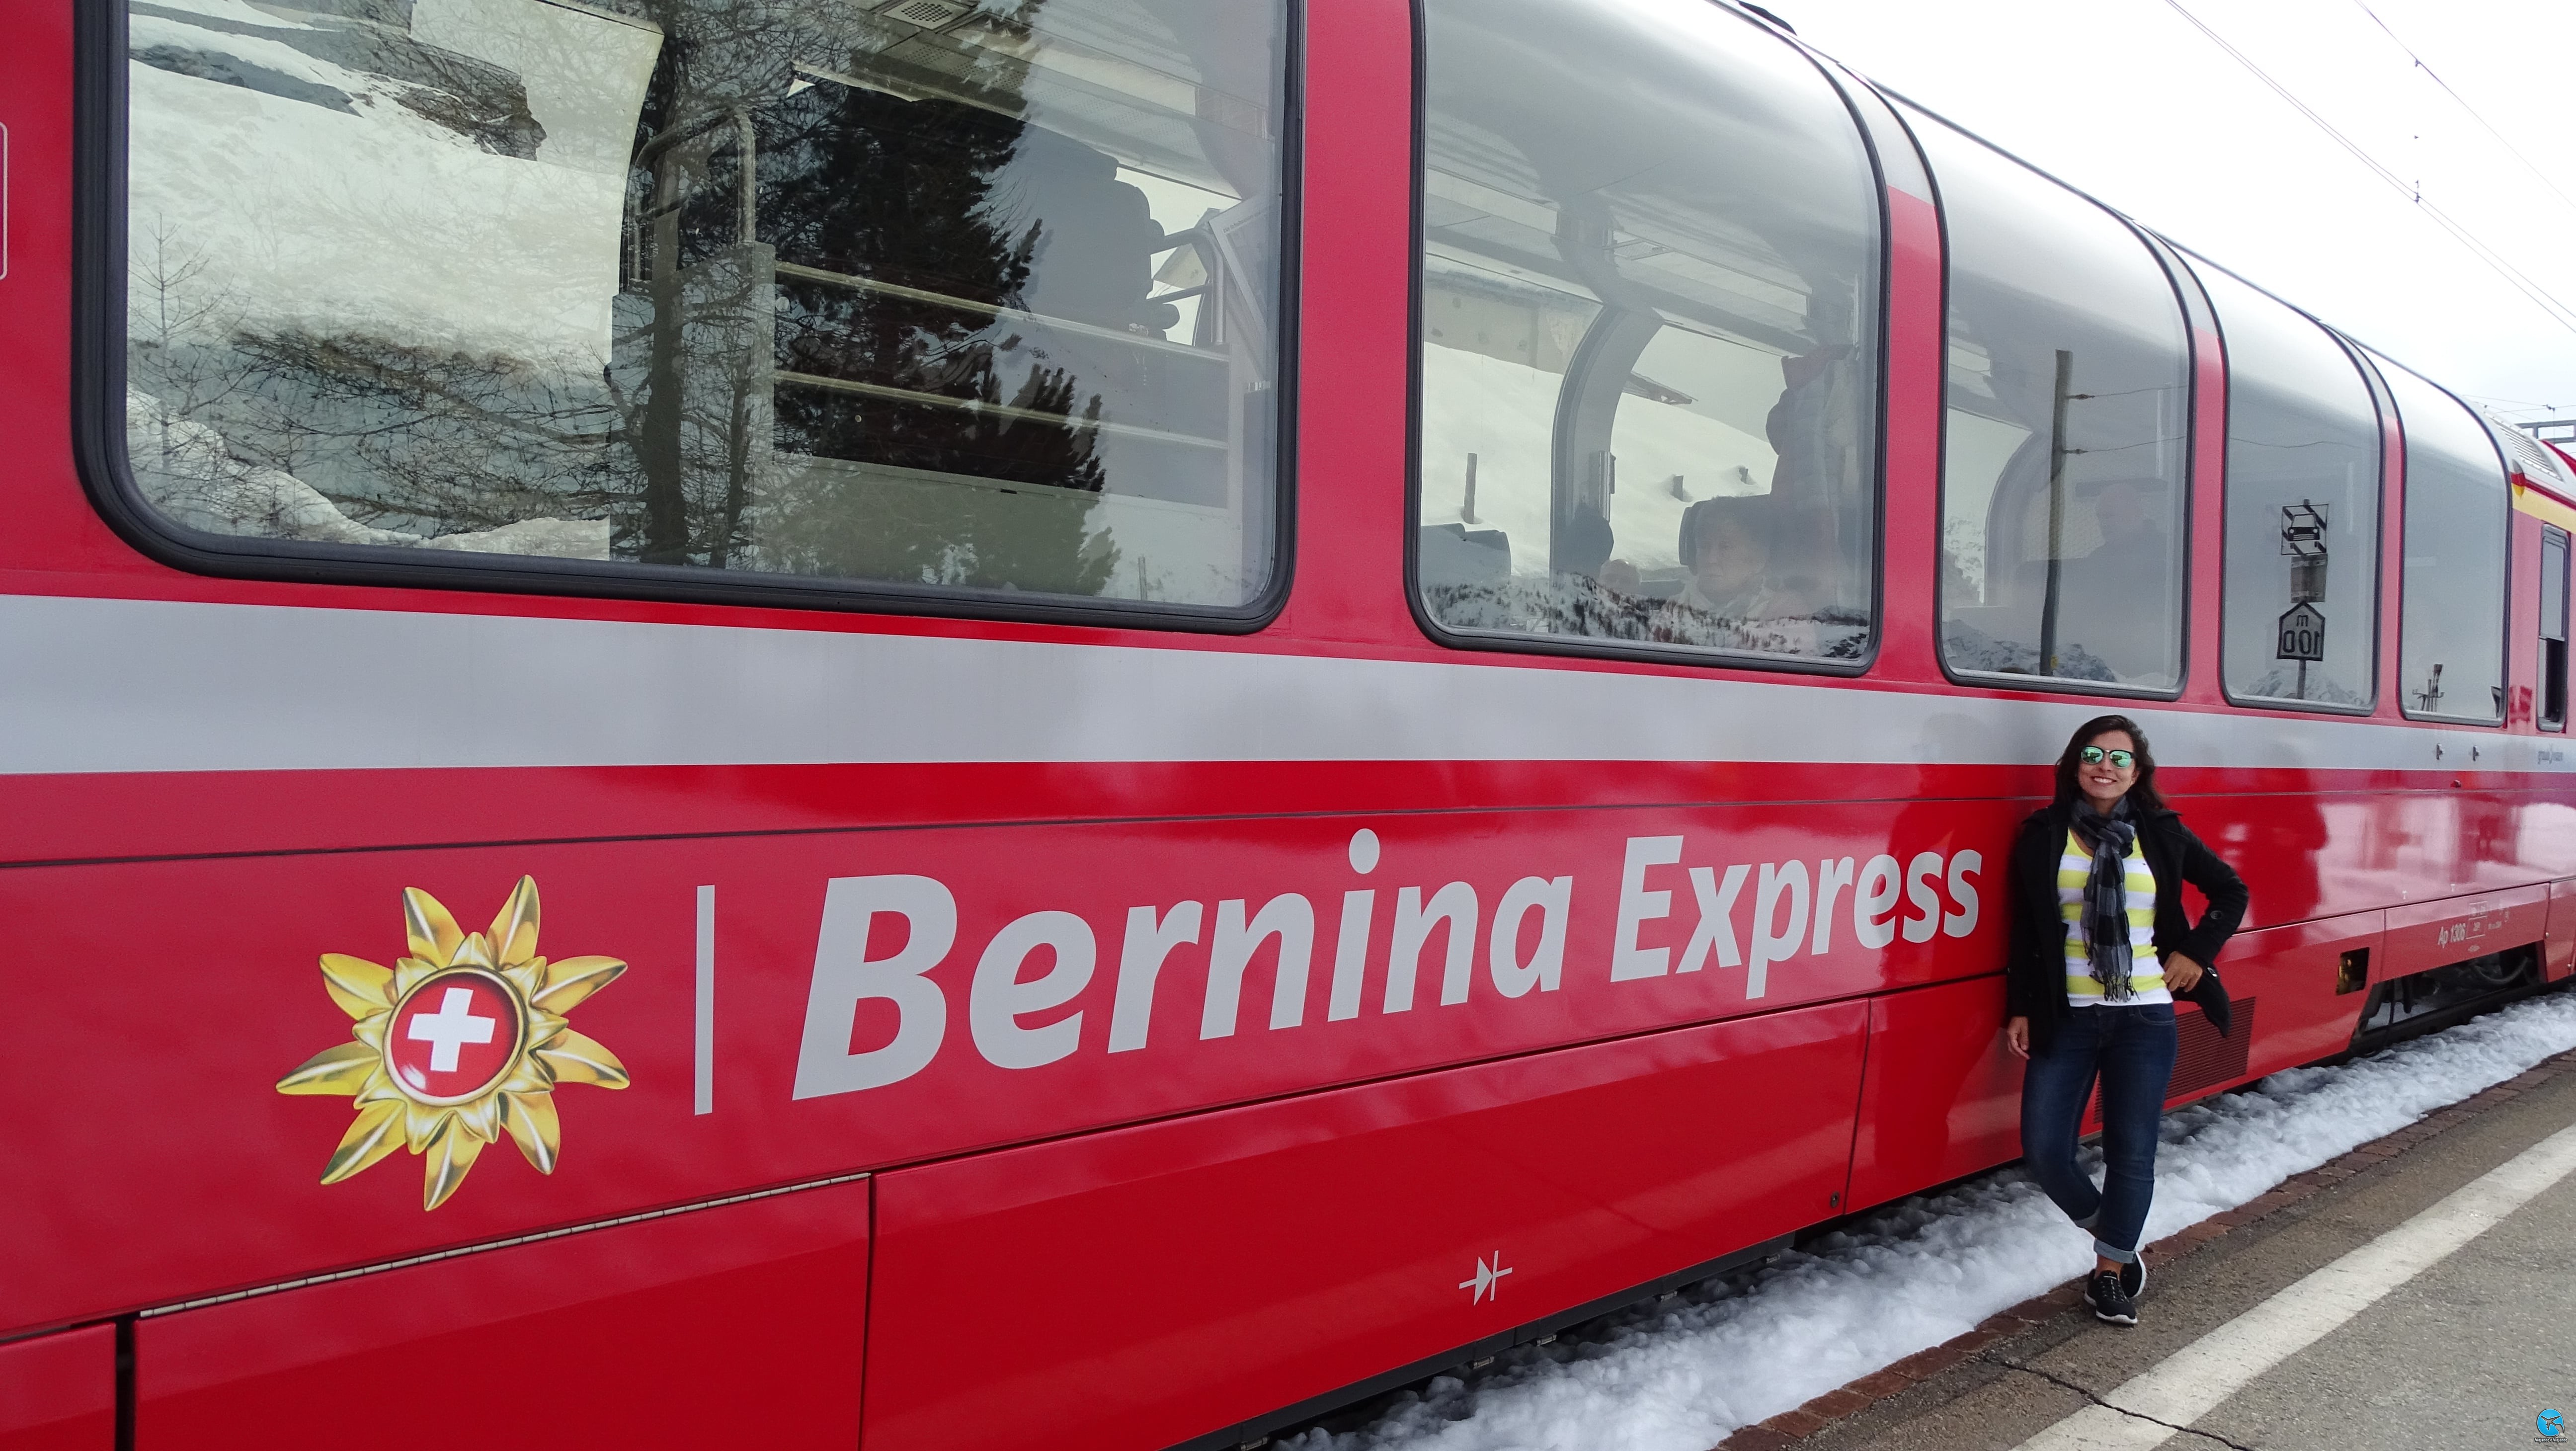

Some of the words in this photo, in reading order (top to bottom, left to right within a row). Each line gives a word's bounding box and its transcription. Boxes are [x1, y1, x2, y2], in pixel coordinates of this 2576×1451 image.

[792, 828, 1574, 1101] Bernina
[1610, 834, 1982, 1000] Express
[2437, 926, 2448, 949] Ap
